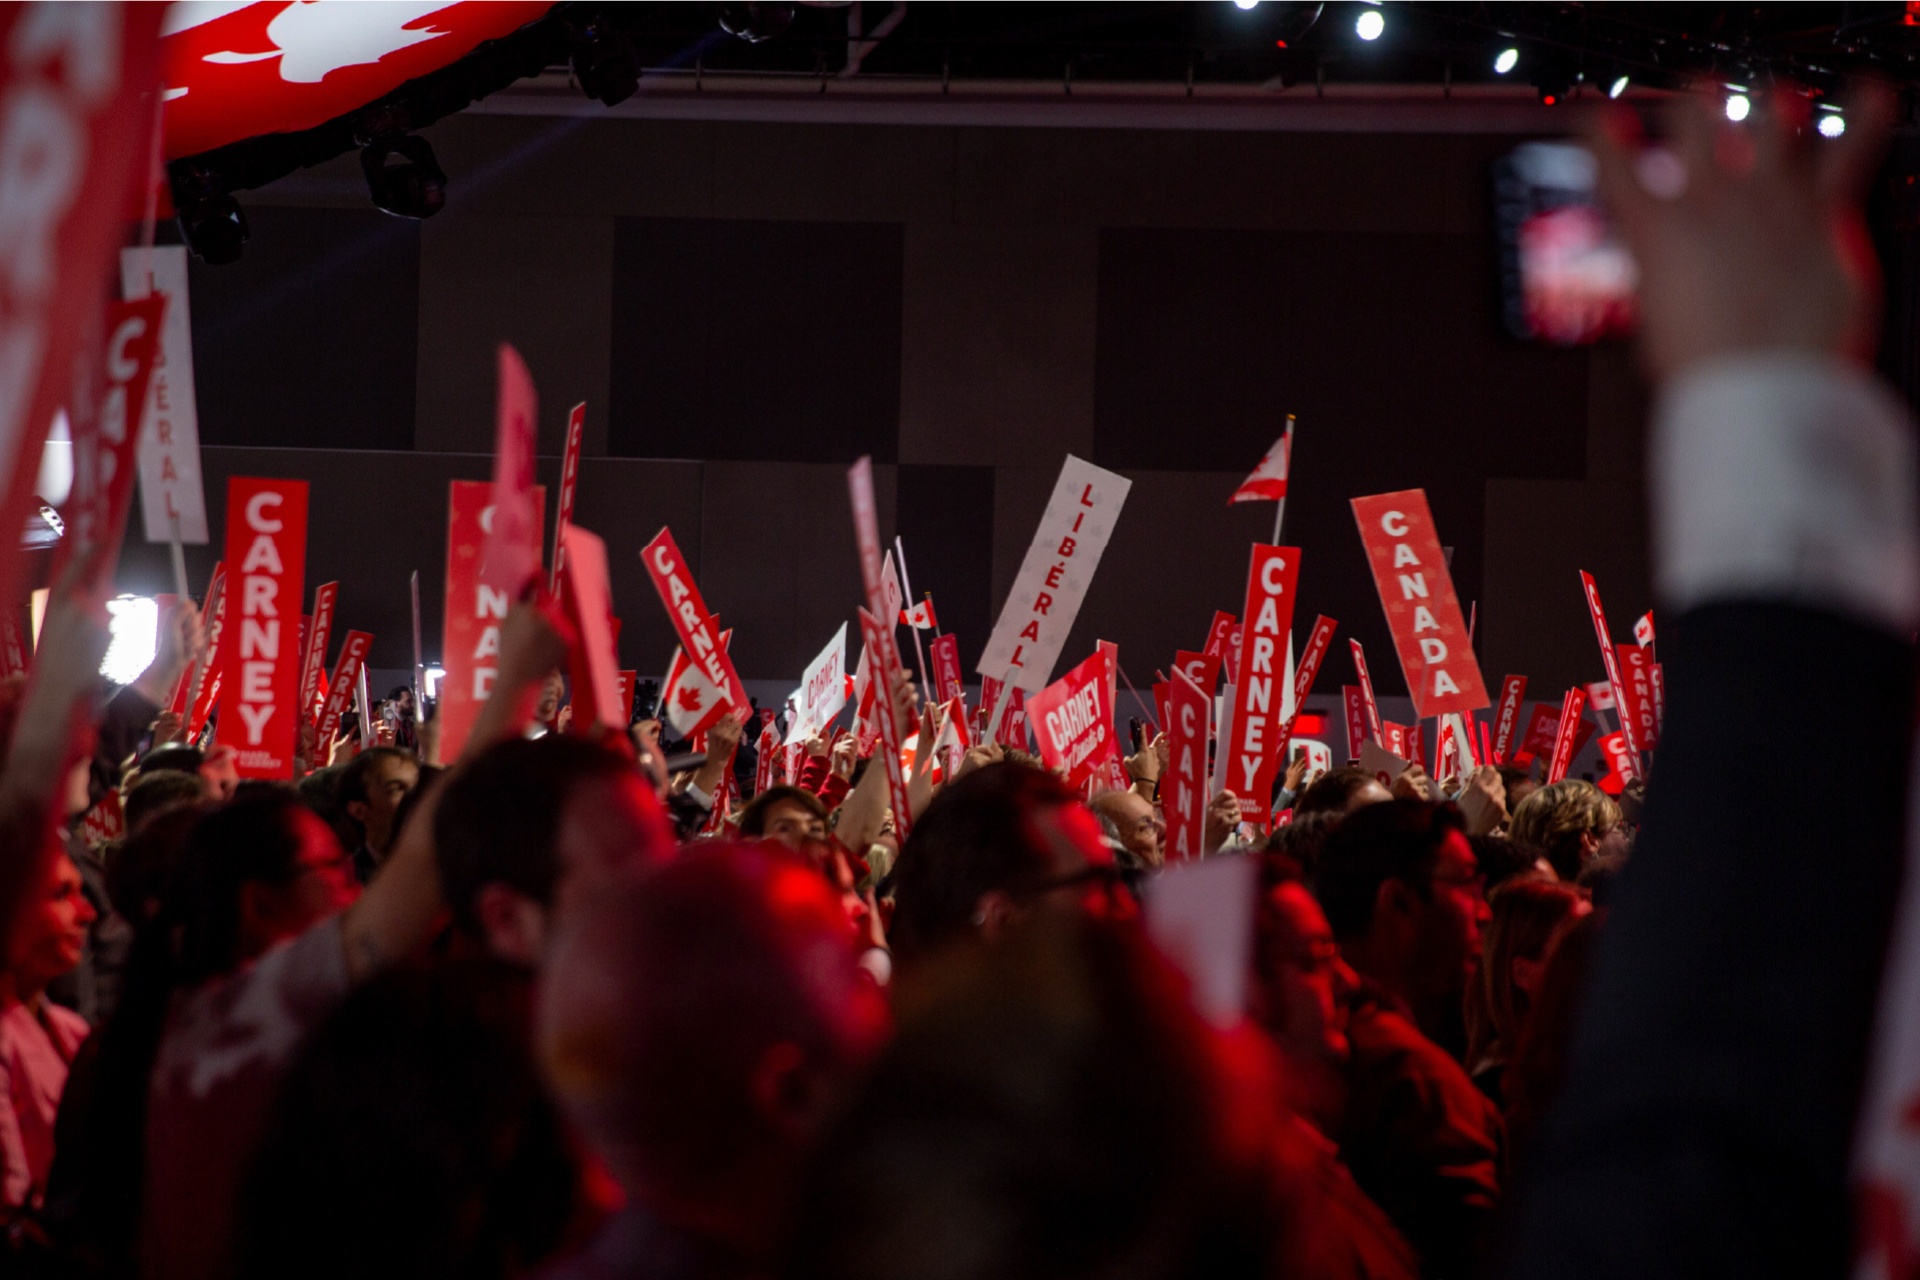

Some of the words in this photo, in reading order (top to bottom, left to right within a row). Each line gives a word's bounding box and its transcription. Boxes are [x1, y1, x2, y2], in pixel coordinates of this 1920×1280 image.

[148, 271, 180, 518] LÉRAL
[238, 491, 283, 746] CARNEY
[305, 589, 332, 708] CARNEY
[655, 546, 735, 707] CARNEY
[1011, 483, 1093, 667] LIBÉRAL
[1381, 511, 1460, 697] CANADA
[318, 637, 365, 750] CARNEY
[1045, 677, 1101, 751] CARNEY
[1241, 557, 1286, 792] CARNEY
[1554, 697, 1581, 780] CARN
[1629, 653, 1656, 742] CANADA
[1175, 702, 1196, 863] CANA
